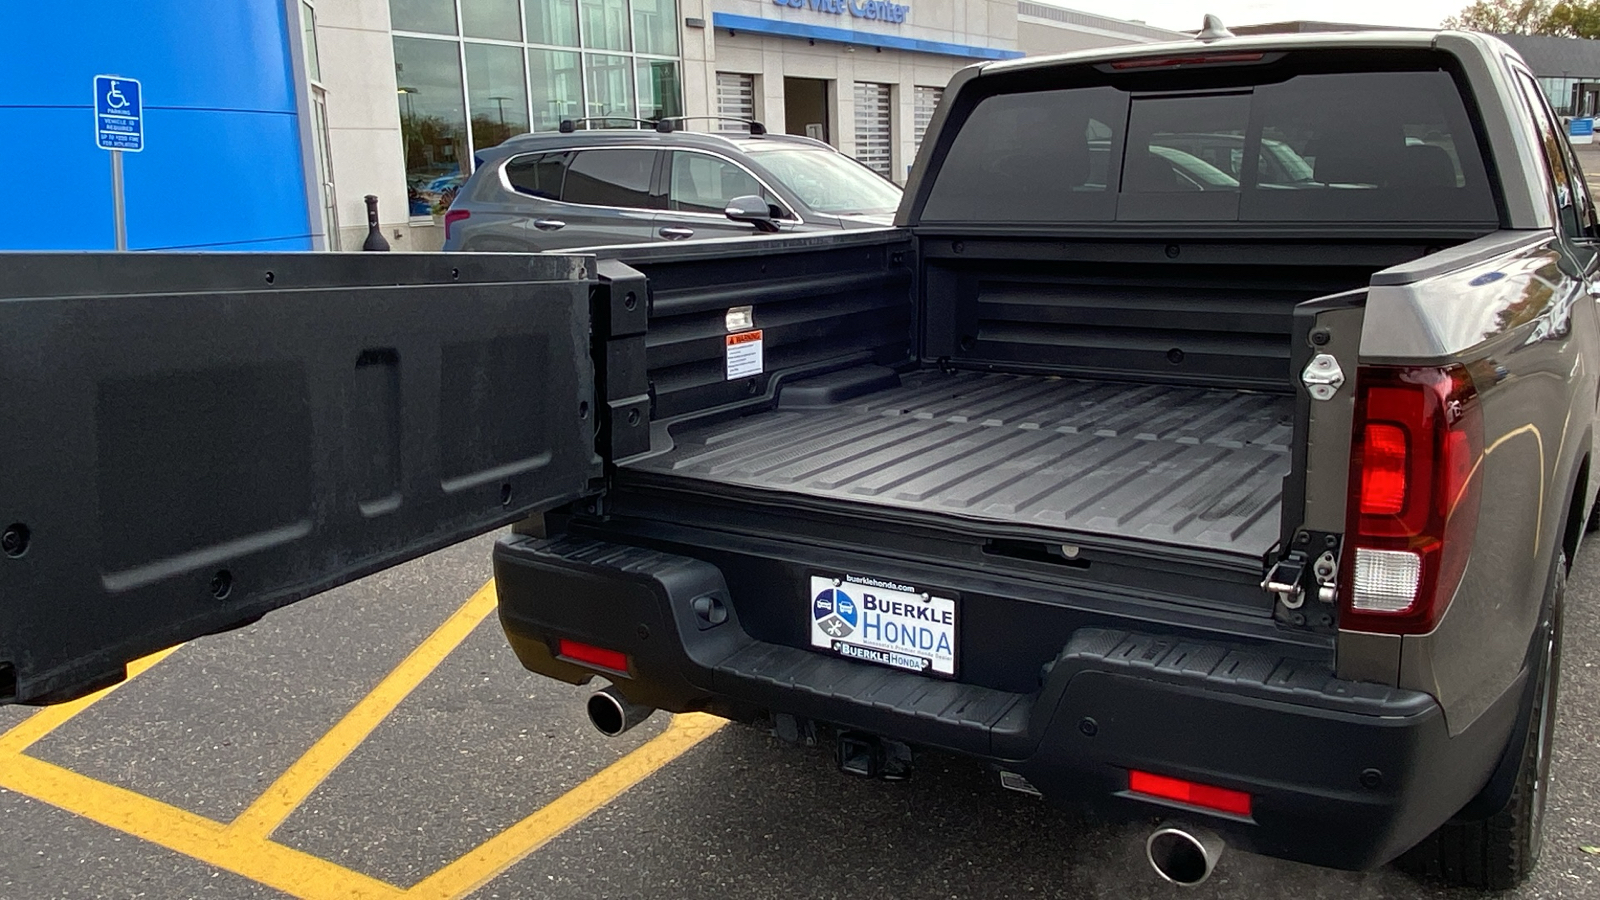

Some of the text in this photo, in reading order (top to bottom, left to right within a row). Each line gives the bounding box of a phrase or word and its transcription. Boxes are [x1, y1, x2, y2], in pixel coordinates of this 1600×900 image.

[772, 0, 909, 24] ervice Center
[846, 574, 915, 593] buerklehonda.com
[863, 593, 953, 625] BUERKLE
[863, 611, 952, 655] HONDA
[863, 640, 894, 649] Minnesota's
[895, 645, 916, 653] Premier
